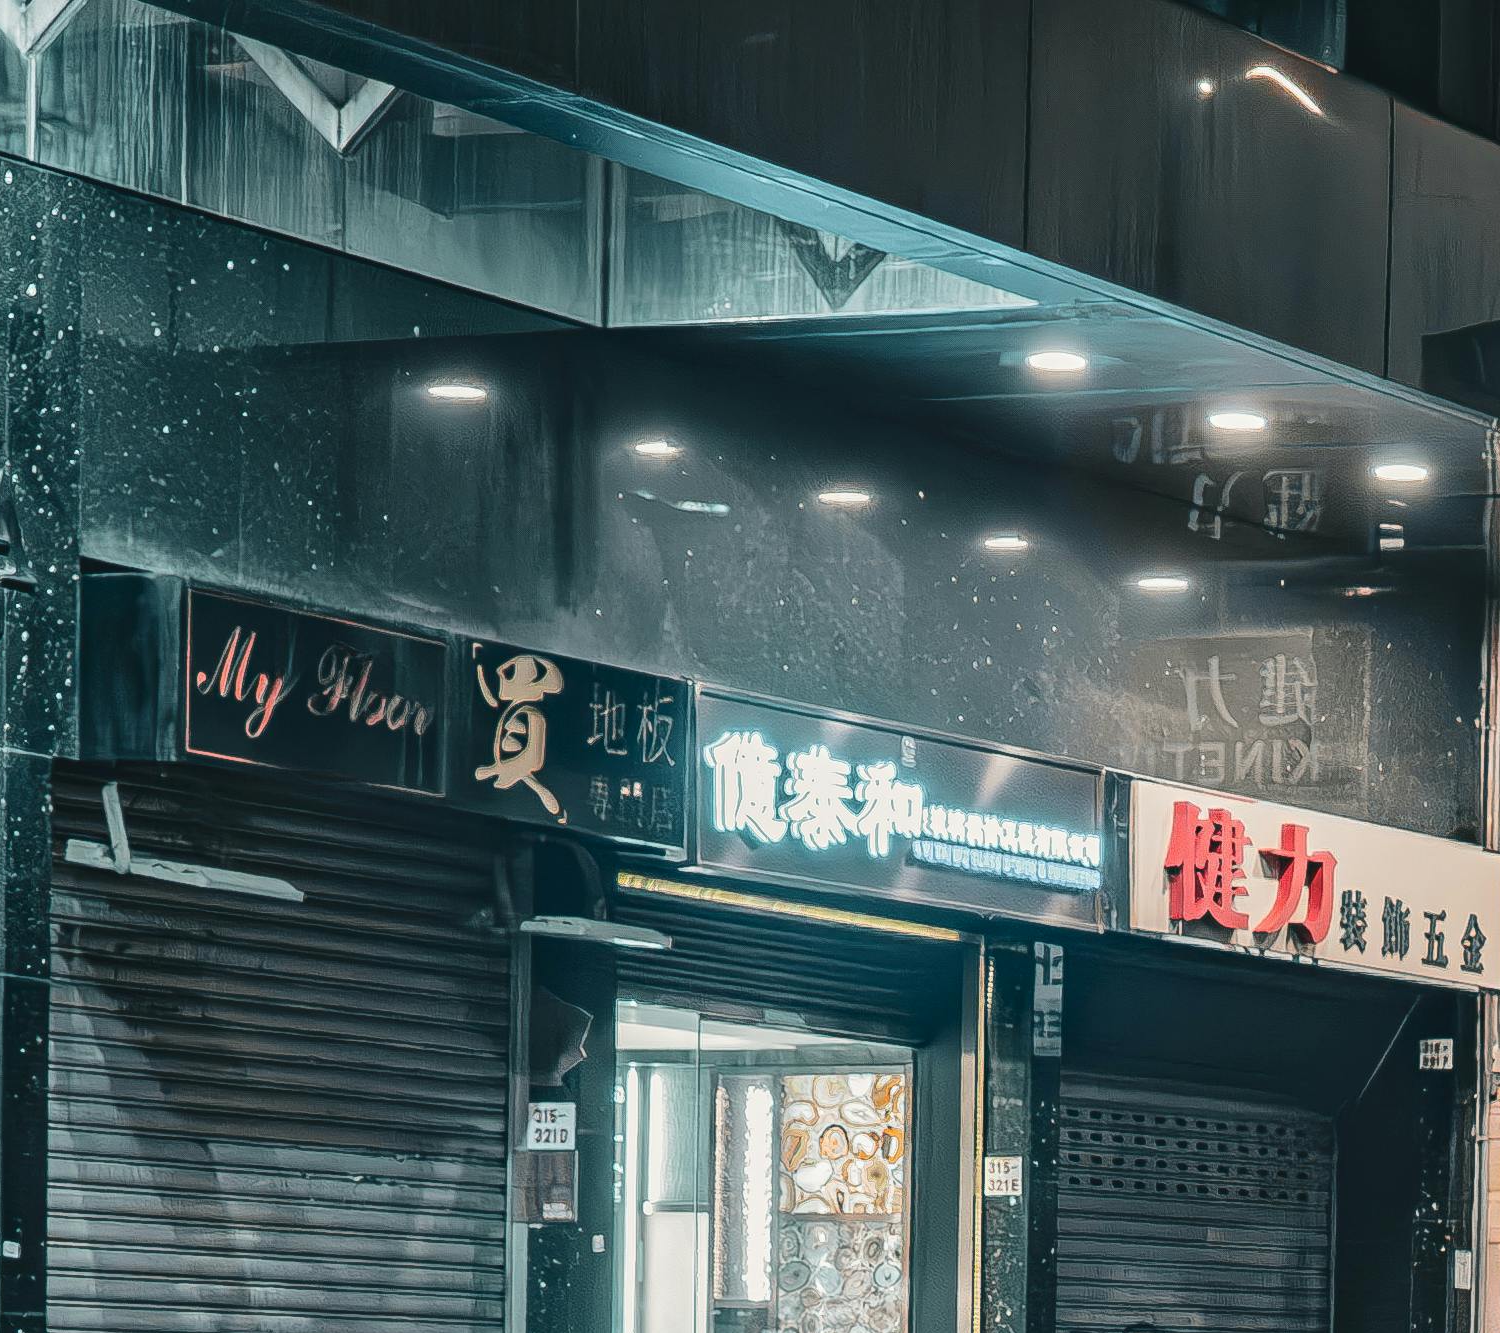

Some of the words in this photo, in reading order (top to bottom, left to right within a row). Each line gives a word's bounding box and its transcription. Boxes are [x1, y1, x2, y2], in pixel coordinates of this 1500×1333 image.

[197, 625, 286, 740] My
[588, 680, 677, 769] 地板
[1165, 799, 1339, 947] 健力
